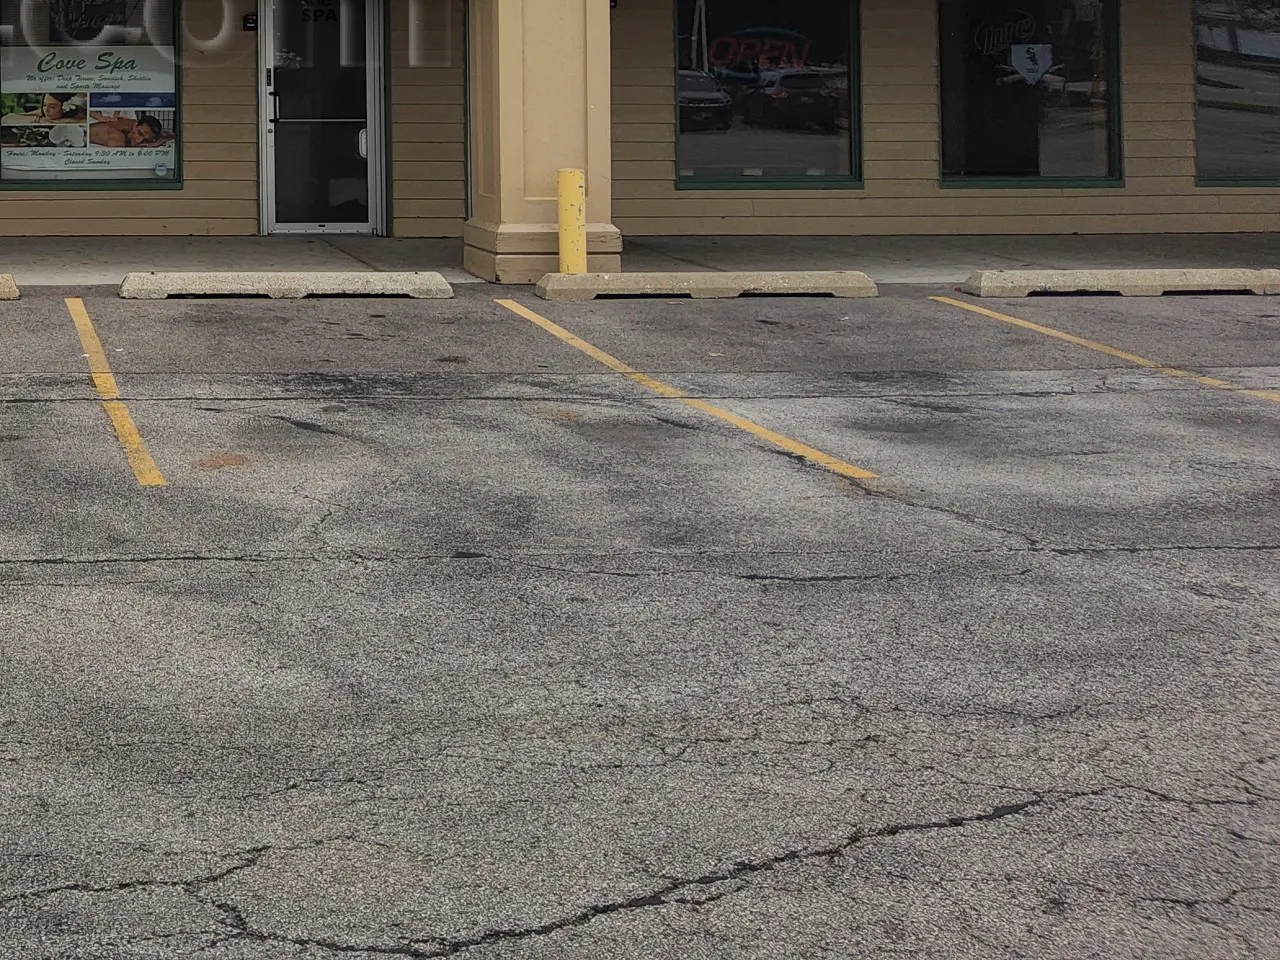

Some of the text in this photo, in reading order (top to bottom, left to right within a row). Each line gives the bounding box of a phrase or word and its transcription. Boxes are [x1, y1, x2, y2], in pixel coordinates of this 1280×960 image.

[301, 9, 337, 22] SPA
[709, 37, 811, 68] OPEN
[37, 52, 138, 74] Cove Spa
[30, 150, 57, 158] Monday
[63, 150, 92, 158] Saturday
[87, 158, 111, 166] Sunday
